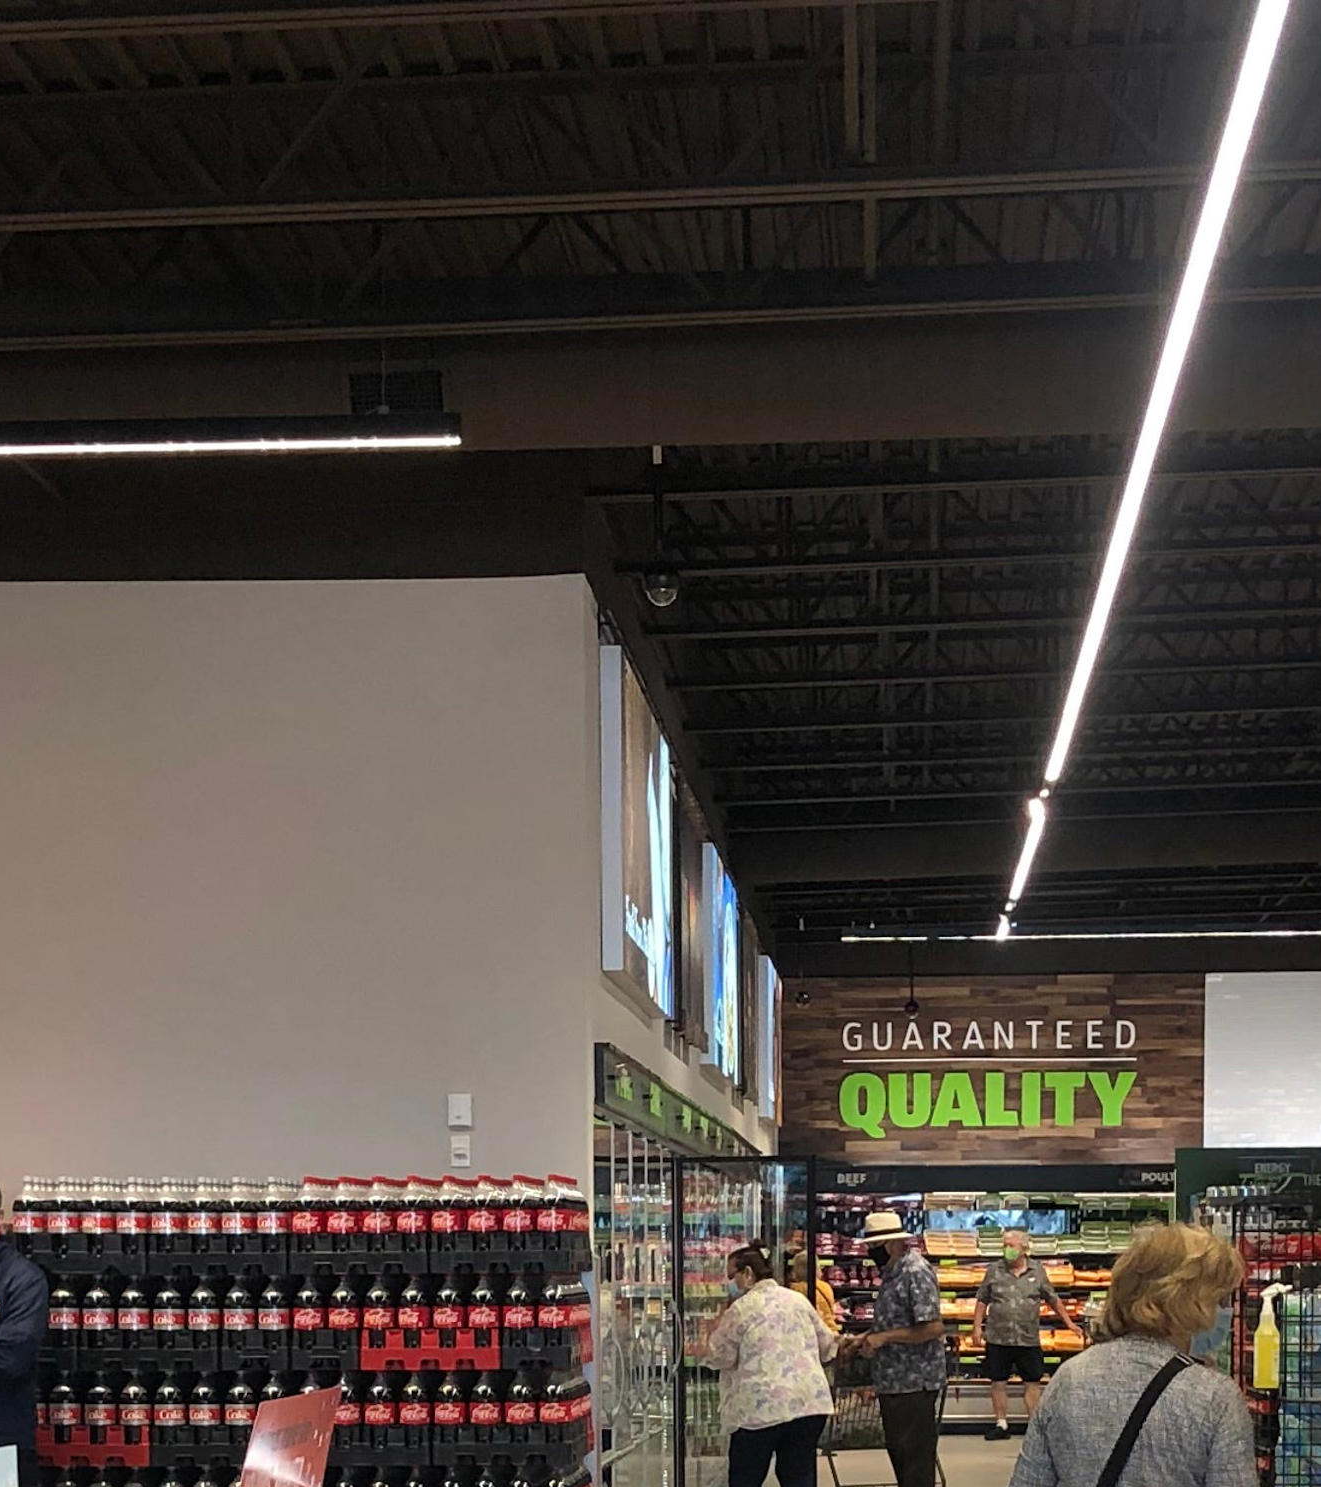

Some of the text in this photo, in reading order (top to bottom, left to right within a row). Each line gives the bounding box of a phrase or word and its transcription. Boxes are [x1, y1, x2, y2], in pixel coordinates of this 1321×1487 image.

[842, 1019, 1137, 1052] GUARANTEED
[839, 1071, 1138, 1139] QUALITY
[837, 1173, 867, 1185] BEEF
[1141, 1171, 1175, 1184] POULT
[122, 1409, 147, 1420] Coke
[159, 1409, 184, 1420] Coke
